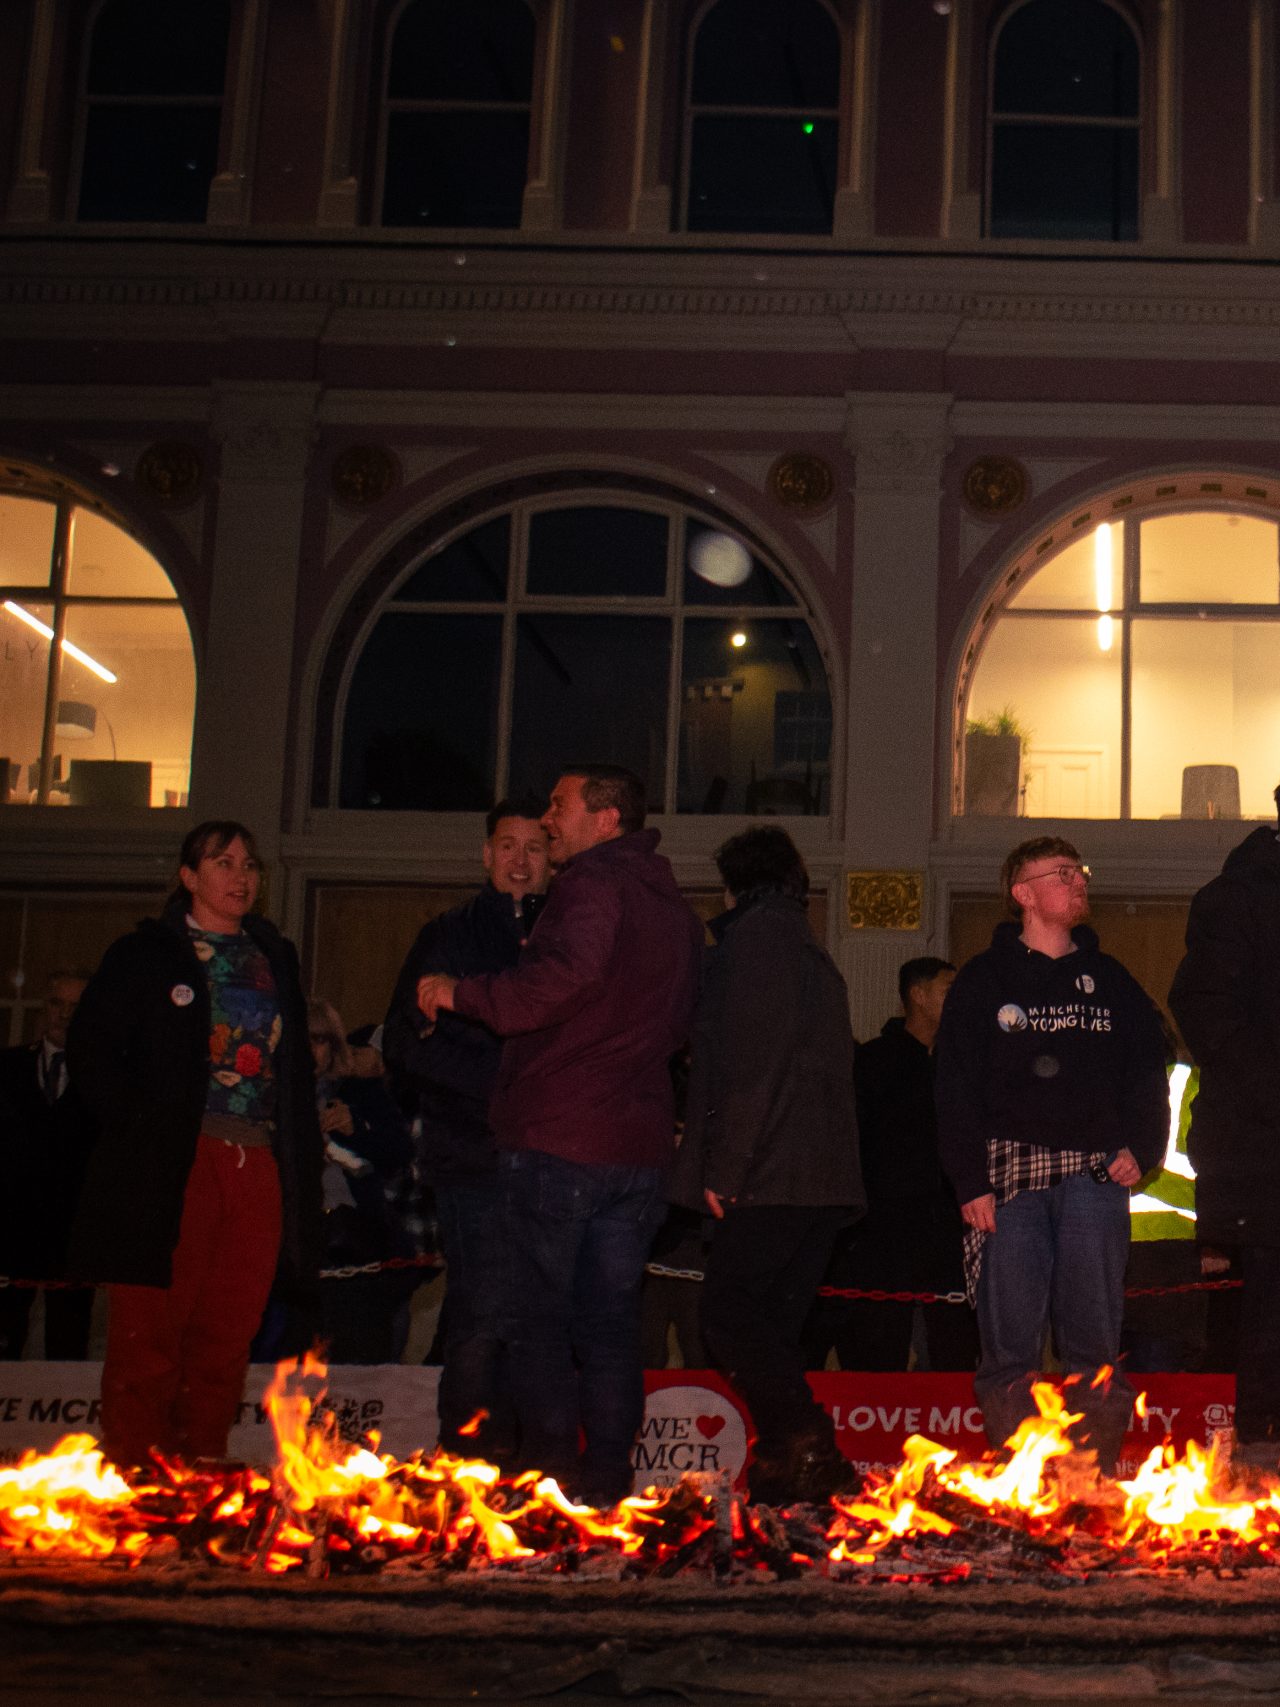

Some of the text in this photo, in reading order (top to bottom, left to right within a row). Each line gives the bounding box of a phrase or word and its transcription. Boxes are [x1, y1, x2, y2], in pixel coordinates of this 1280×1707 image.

[1029, 1015, 1112, 1032] YOUNG LVES
[640, 1417, 691, 1439] WE
[832, 1405, 922, 1433] LOVE
[634, 1442, 720, 1471] MCR
